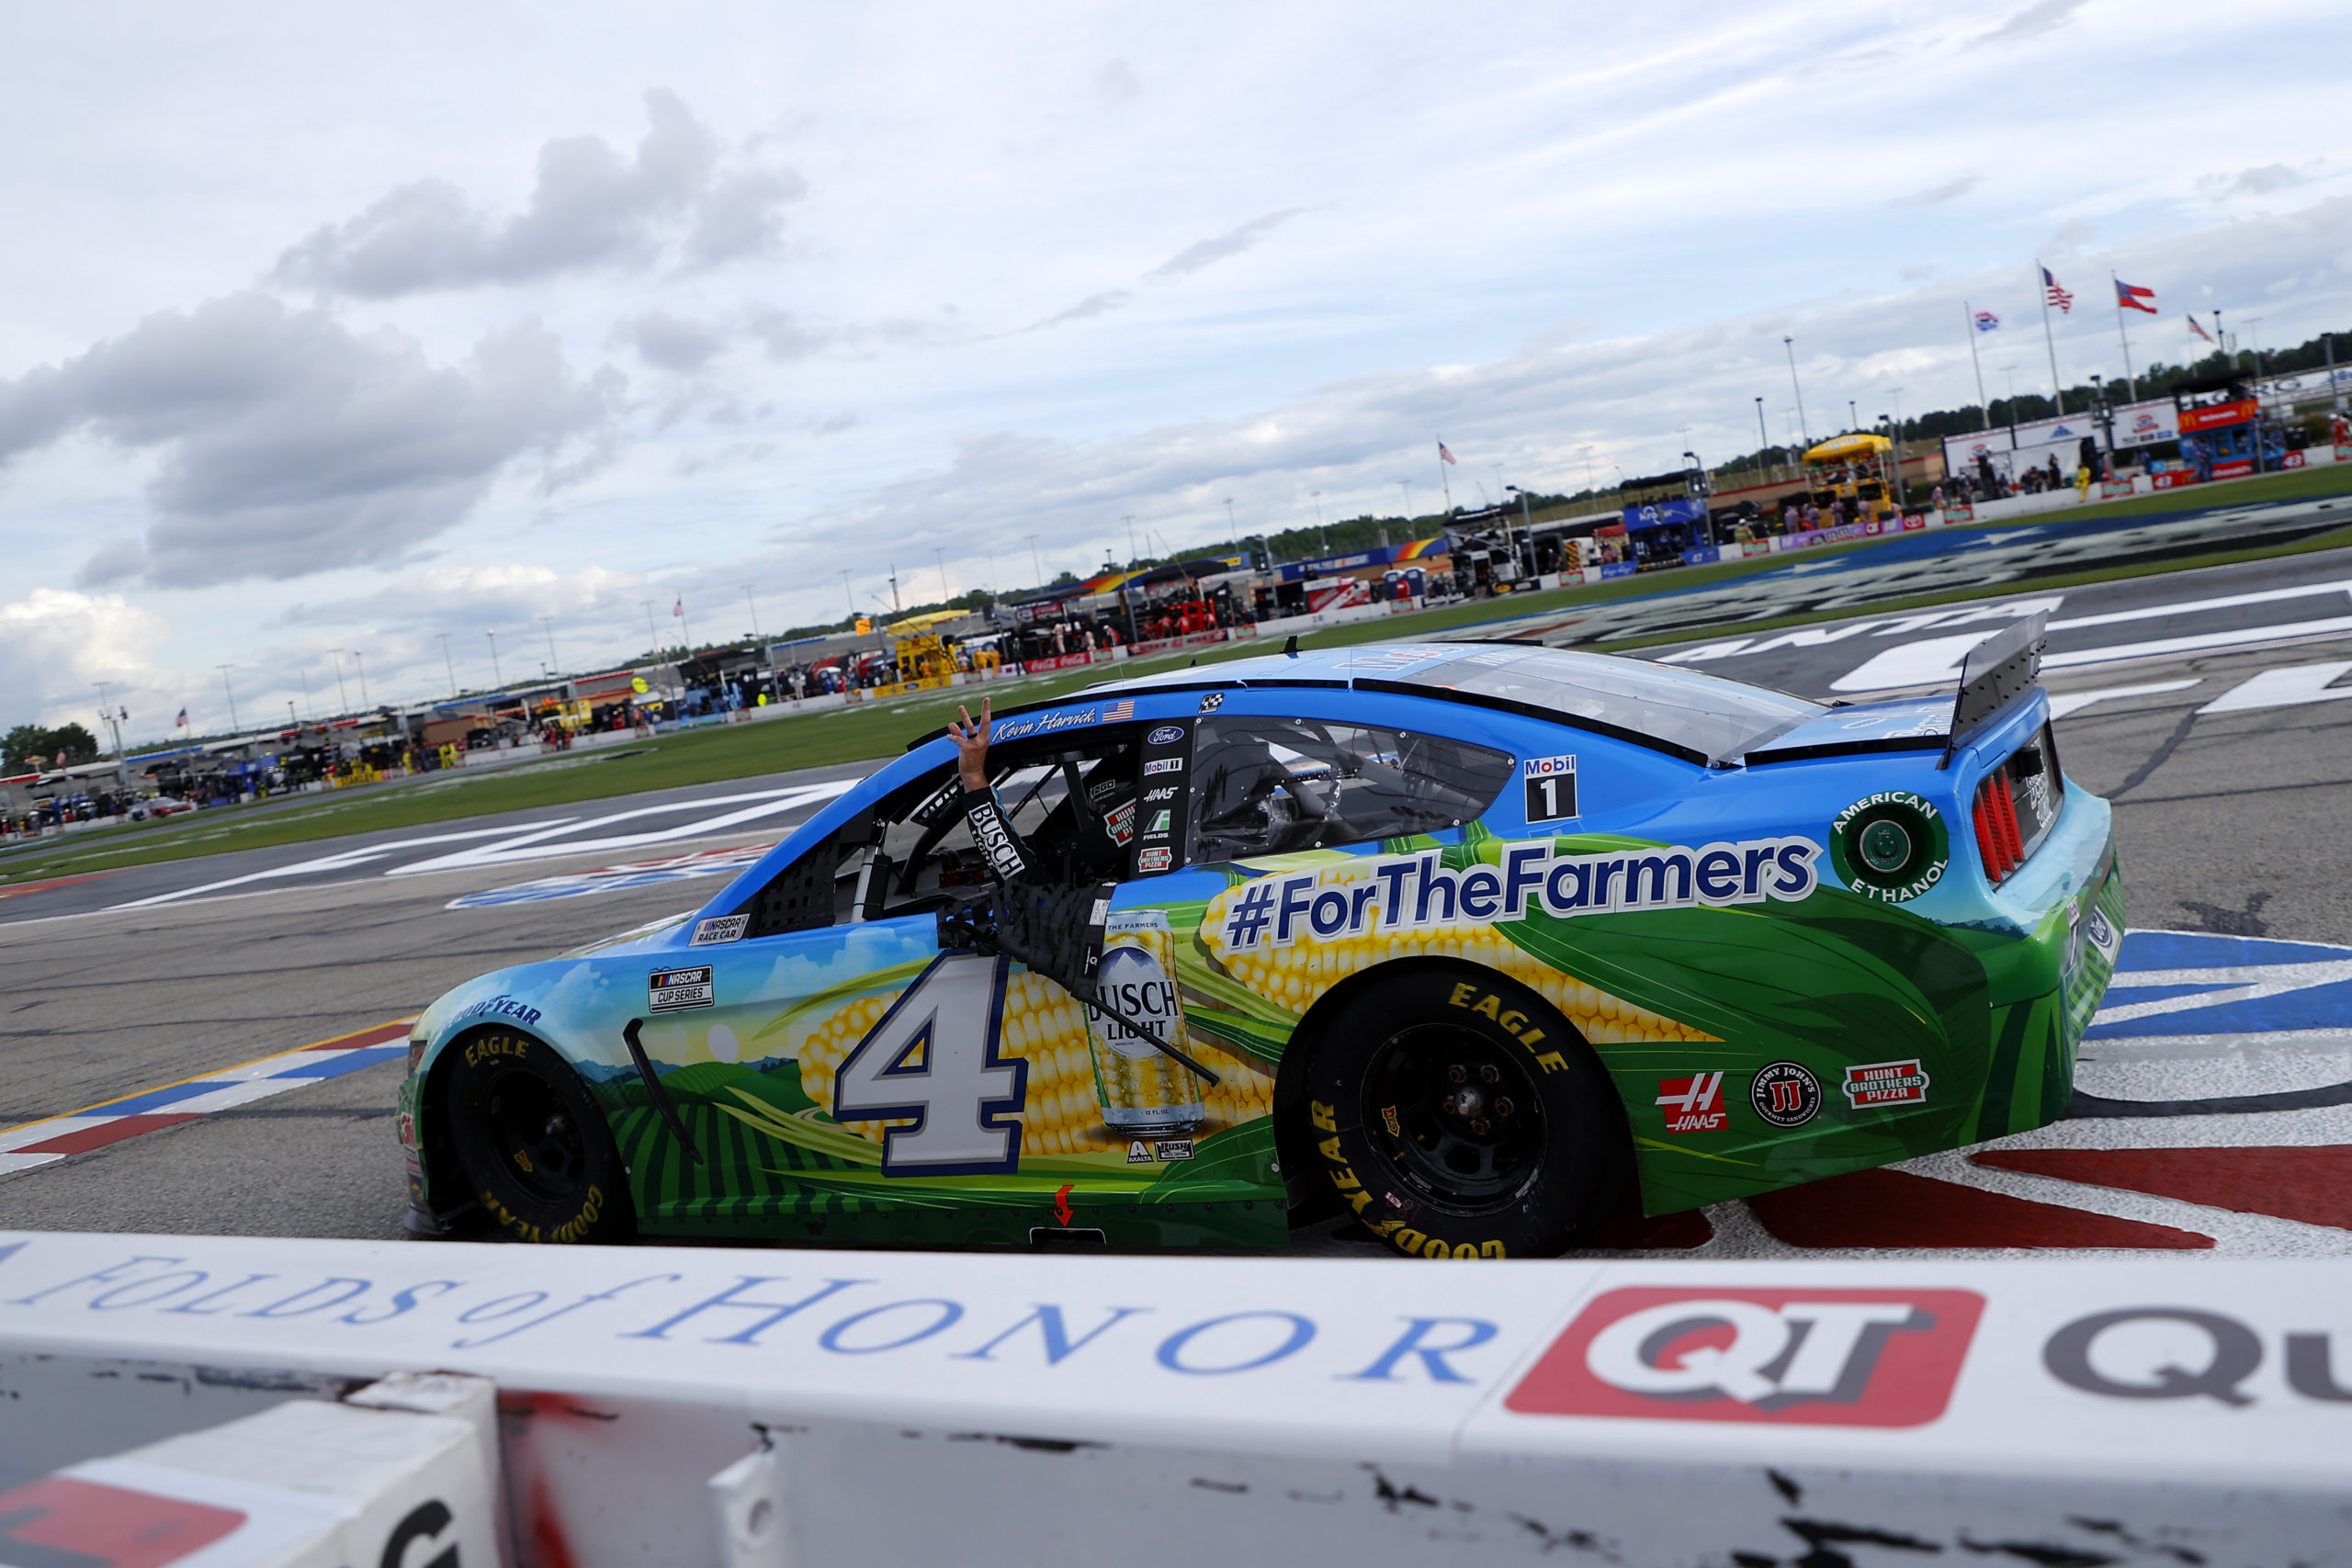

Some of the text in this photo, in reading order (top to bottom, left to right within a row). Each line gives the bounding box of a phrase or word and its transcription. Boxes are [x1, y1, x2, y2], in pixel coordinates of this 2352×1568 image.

[2154, 475, 2174, 489] 43
[992, 708, 1094, 743] Kevin Harvick
[1151, 729, 1177, 743] Ford
[1144, 761, 1169, 774] Mobil
[1525, 756, 1575, 775] Mobil
[1143, 786, 1179, 802] HAAS
[1540, 779, 1557, 817] 1
[1115, 804, 1136, 823] HUN
[1832, 791, 1938, 835] AMERICAN
[968, 802, 1025, 880] BUSCH
[1143, 832, 1169, 840] FIELDS
[972, 830, 994, 869] LIGHT
[1140, 854, 1170, 863] BROTHERS
[1146, 850, 1163, 858] HUNT
[1850, 858, 1949, 903] ETHANOL
[1225, 844, 1815, 948] #ForTheFarmers
[709, 918, 741, 931] NASCAR
[1125, 921, 1159, 930] FARMERS
[696, 930, 738, 943] RACE CAR
[667, 970, 704, 987] NASCAR
[657, 987, 704, 1003] CUP SERIES
[1448, 982, 1569, 1075] EAGLE
[465, 1036, 529, 1068] EAGLE
[833, 949, 1029, 1179] 4
[1863, 1066, 1904, 1081] HUNT
[1756, 1066, 1815, 1098] JIMMY JOHN'S
[1849, 1076, 1922, 1093] BROTHERS
[1770, 1079, 1802, 1112] JJ
[1866, 1087, 1908, 1101] PIZZA
[1758, 1097, 1815, 1122] GOURMET SANDWICHES
[1385, 1109, 1397, 1132] AERO
[1666, 1112, 1726, 1131] HAAS
[1160, 1142, 1188, 1152] RUSH
[3, 1255, 1501, 1386] FOLDS of HONOR
[1586, 1298, 1933, 1409] QT
